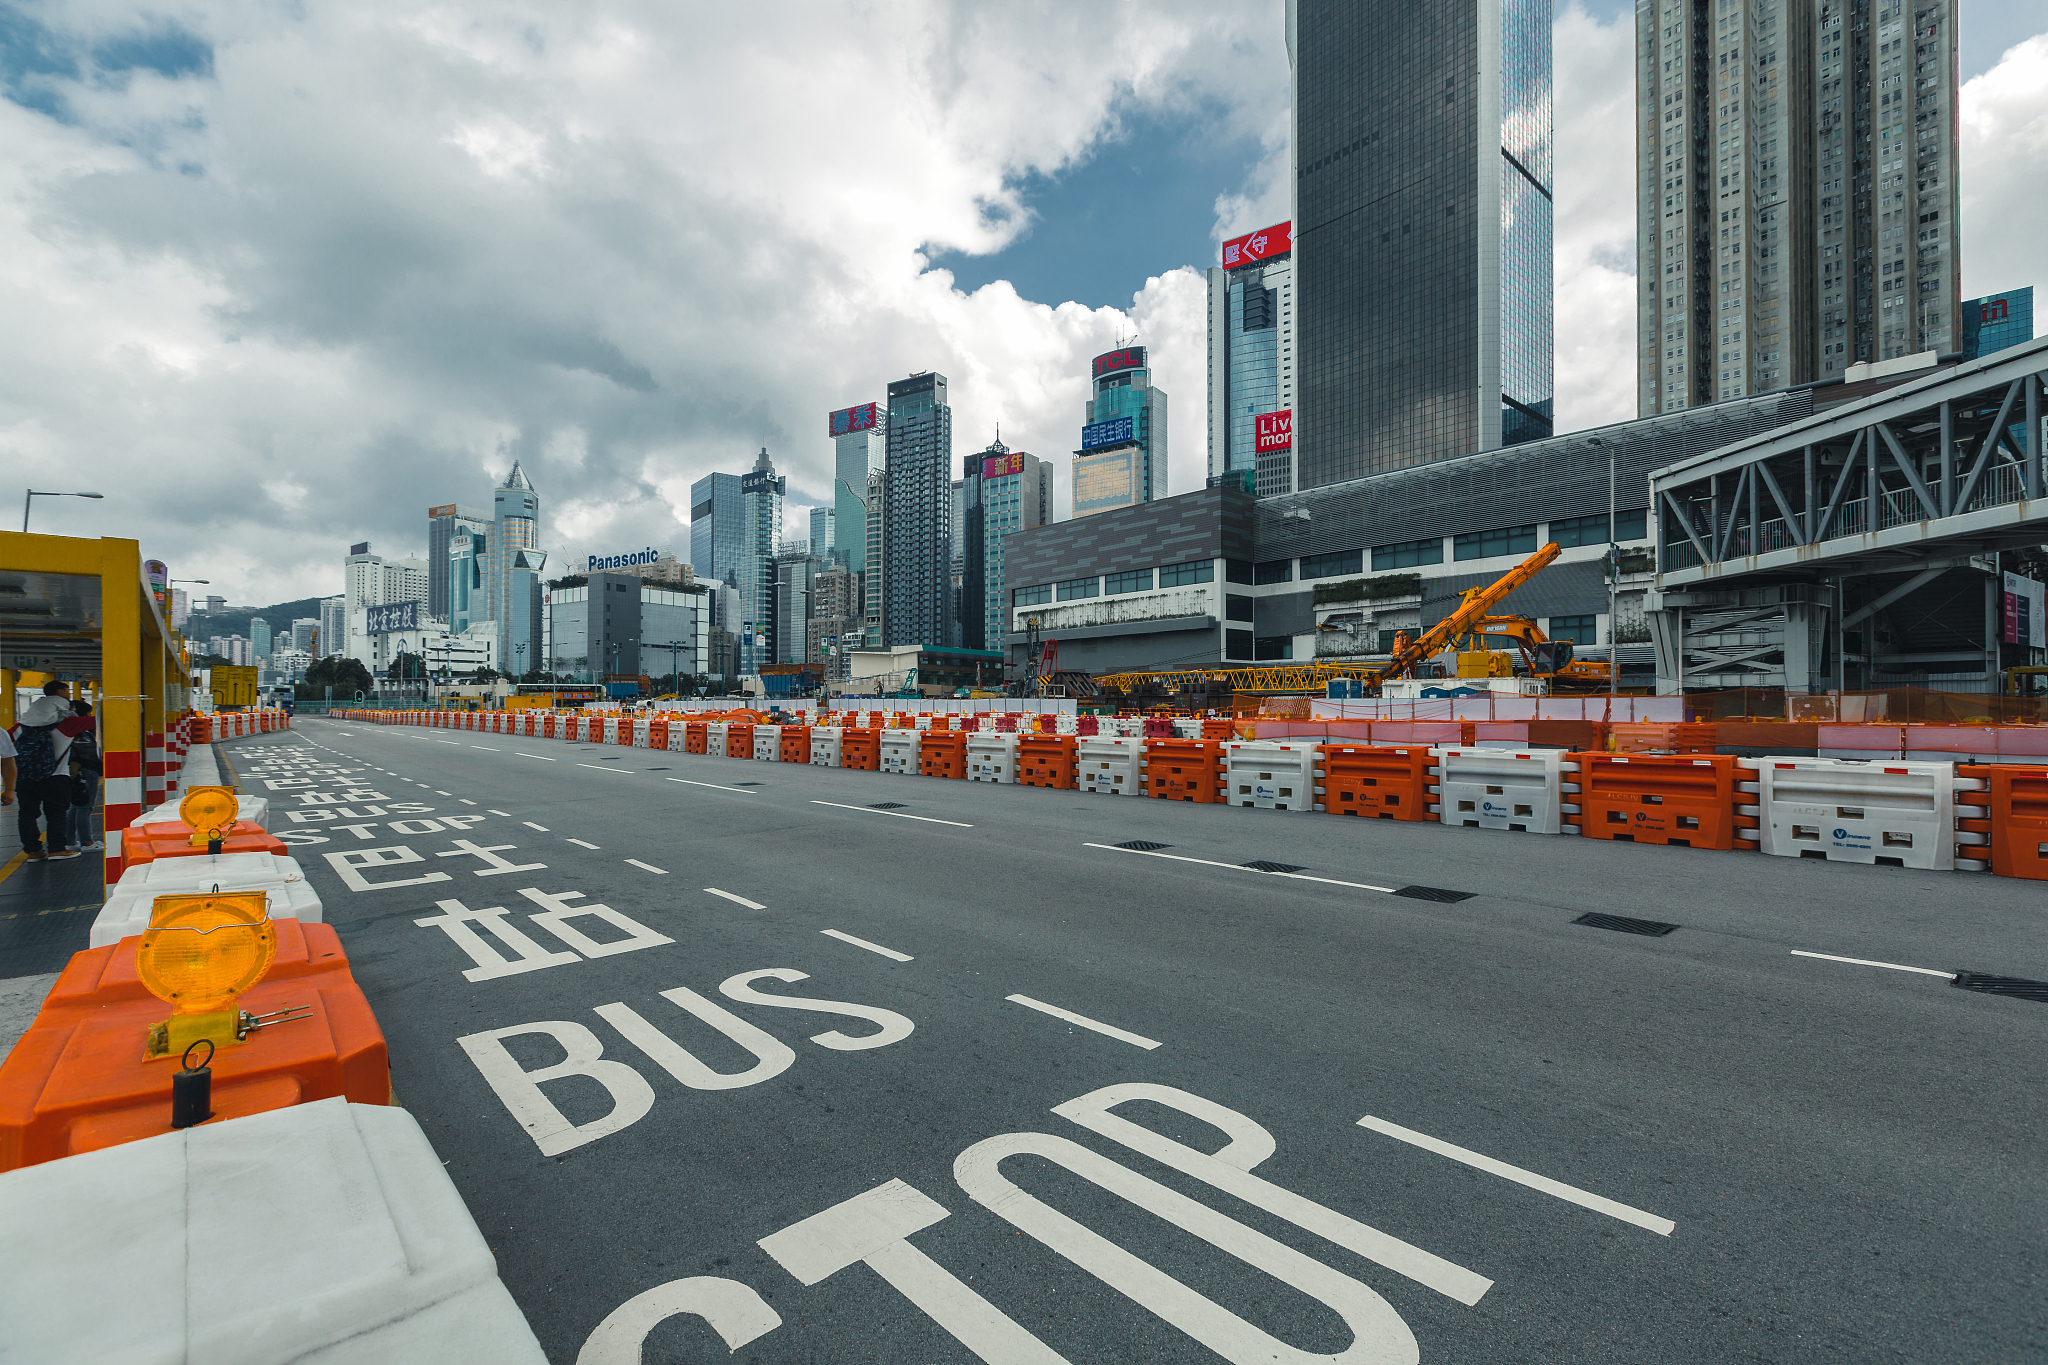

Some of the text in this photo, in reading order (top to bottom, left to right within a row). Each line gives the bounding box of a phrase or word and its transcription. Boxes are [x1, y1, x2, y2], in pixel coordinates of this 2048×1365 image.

[1095, 350, 1138, 373] TCL
[833, 404, 871, 433] 泰禾
[1261, 416, 1292, 435] Liv
[588, 546, 659, 572] Panasonic
[285, 802, 436, 824] BUS
[271, 815, 487, 846] STOP
[413, 887, 677, 983] 站
[456, 967, 916, 1158] BUS
